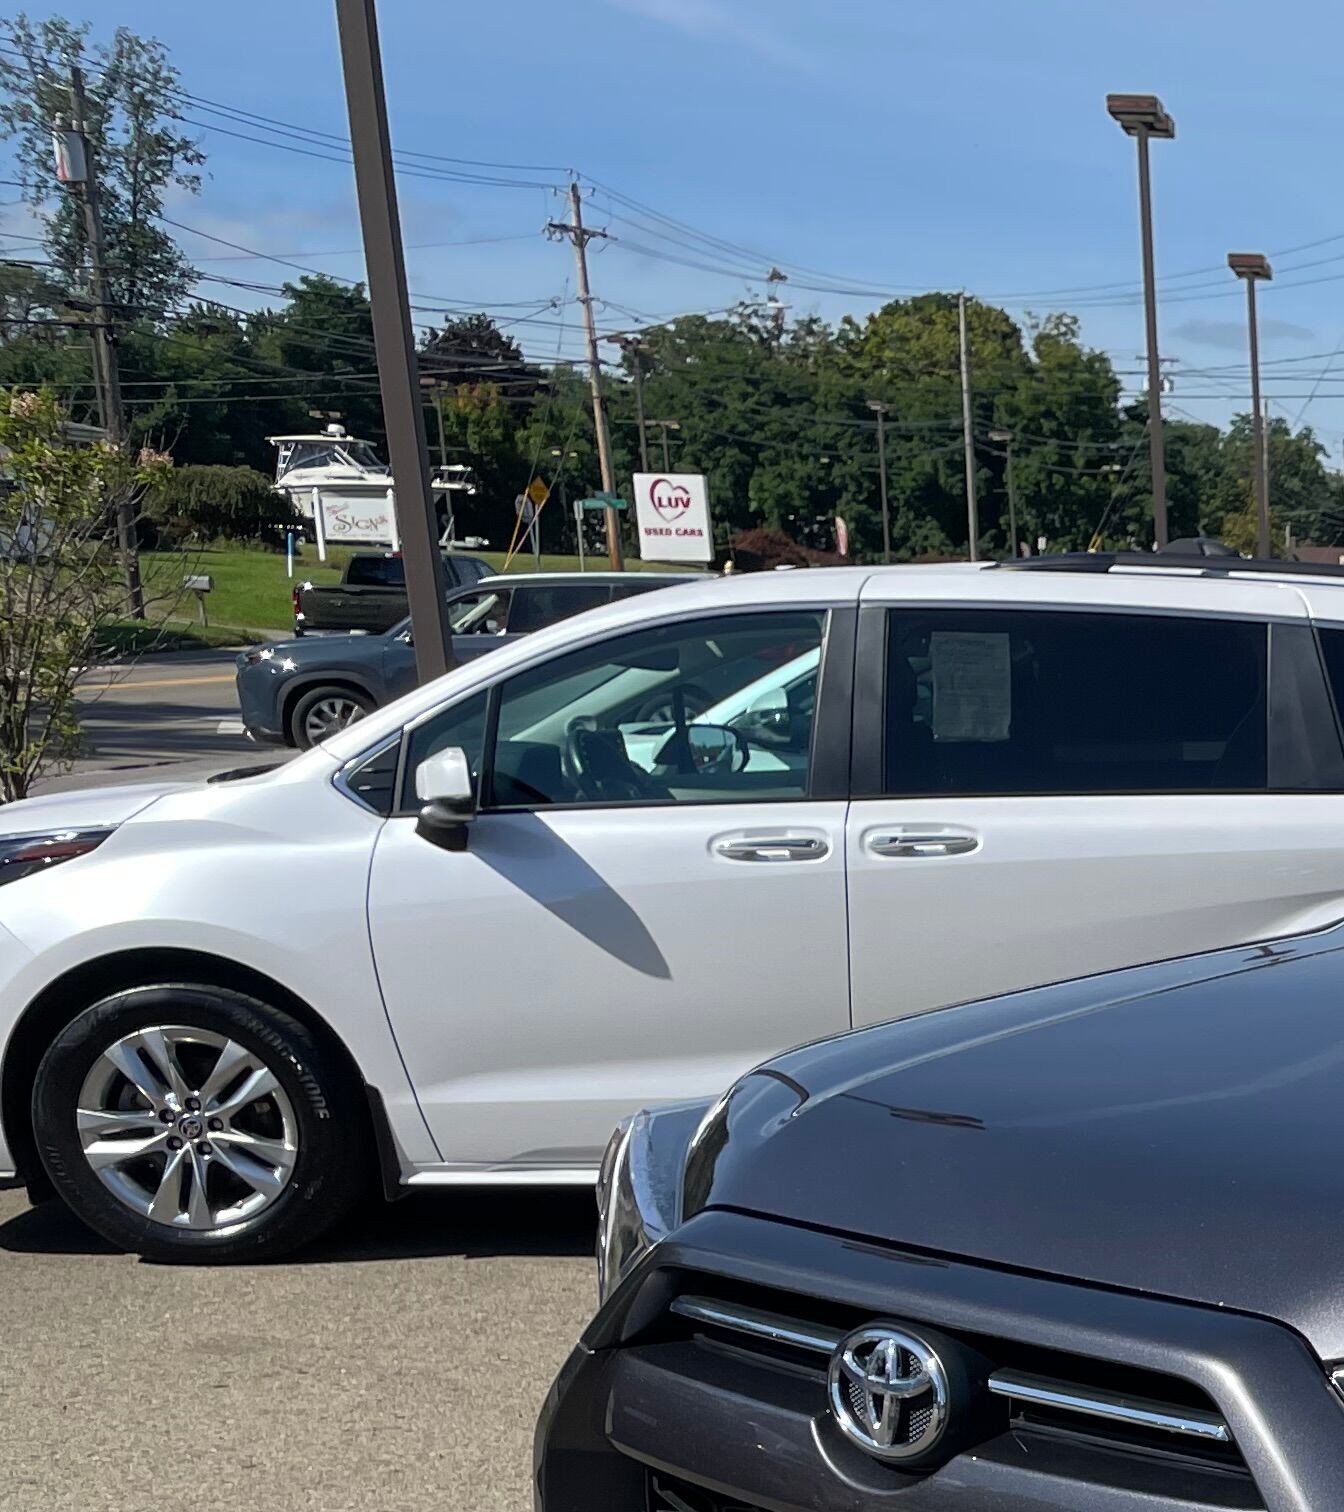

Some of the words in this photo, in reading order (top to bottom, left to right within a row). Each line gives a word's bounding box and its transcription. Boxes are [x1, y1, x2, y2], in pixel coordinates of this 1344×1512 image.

[658, 496, 691, 508] LUV
[644, 528, 672, 536] USED
[675, 528, 703, 537] CARS
